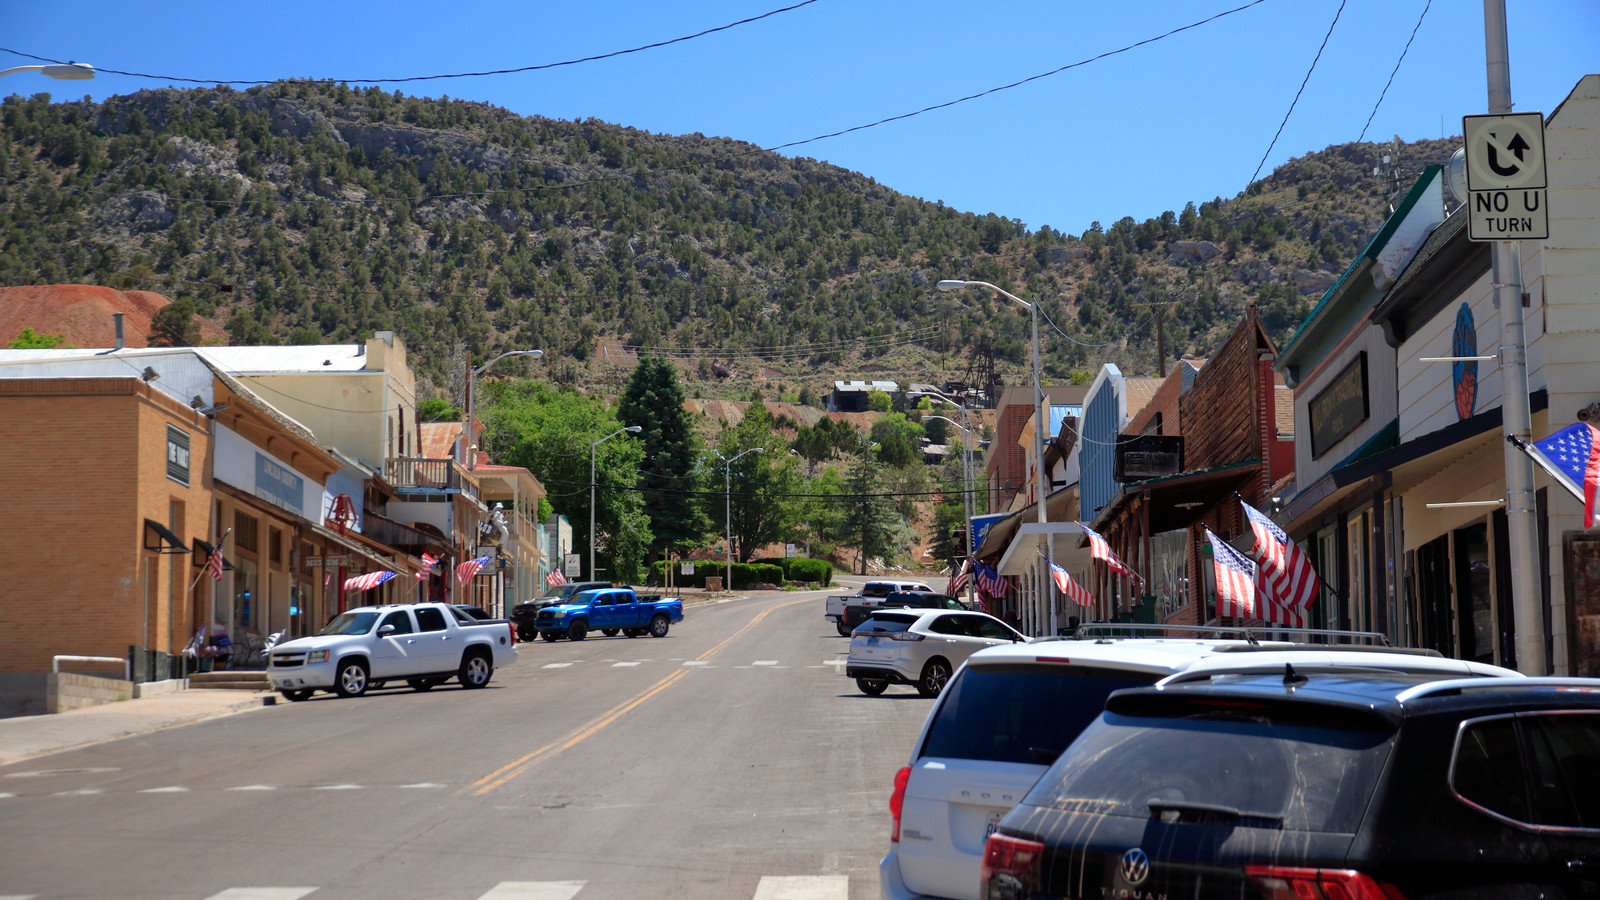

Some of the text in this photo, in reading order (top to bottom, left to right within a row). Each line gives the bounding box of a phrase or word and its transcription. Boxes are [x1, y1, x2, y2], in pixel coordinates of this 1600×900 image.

[1476, 191, 1539, 212] NO U
[1485, 217, 1532, 232] TURN
[1453, 314, 1476, 367] GYM
[306, 558, 339, 567] MUSUM
[1101, 887, 1167, 900] TIGUAN
